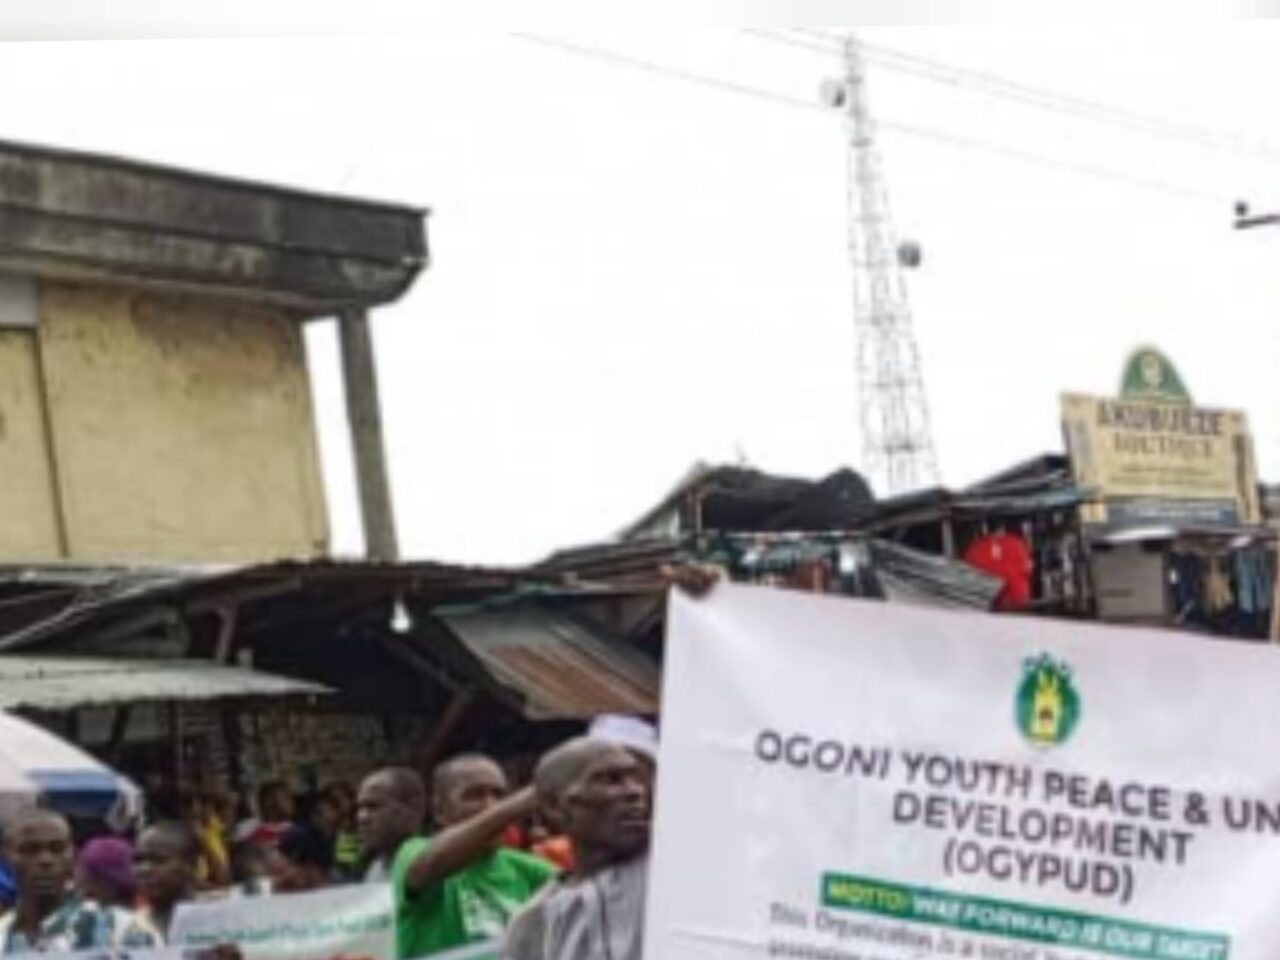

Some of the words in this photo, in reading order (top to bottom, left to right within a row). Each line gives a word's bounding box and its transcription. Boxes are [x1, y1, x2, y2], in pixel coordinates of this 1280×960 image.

[754, 729, 892, 780] OGONI
[902, 750, 1033, 798] YOUTH
[1044, 771, 1171, 822] PEACE
[1183, 790, 1211, 826] &
[892, 791, 1194, 865] DEVELOPMENT
[944, 838, 1134, 906] (OGYPUD)
